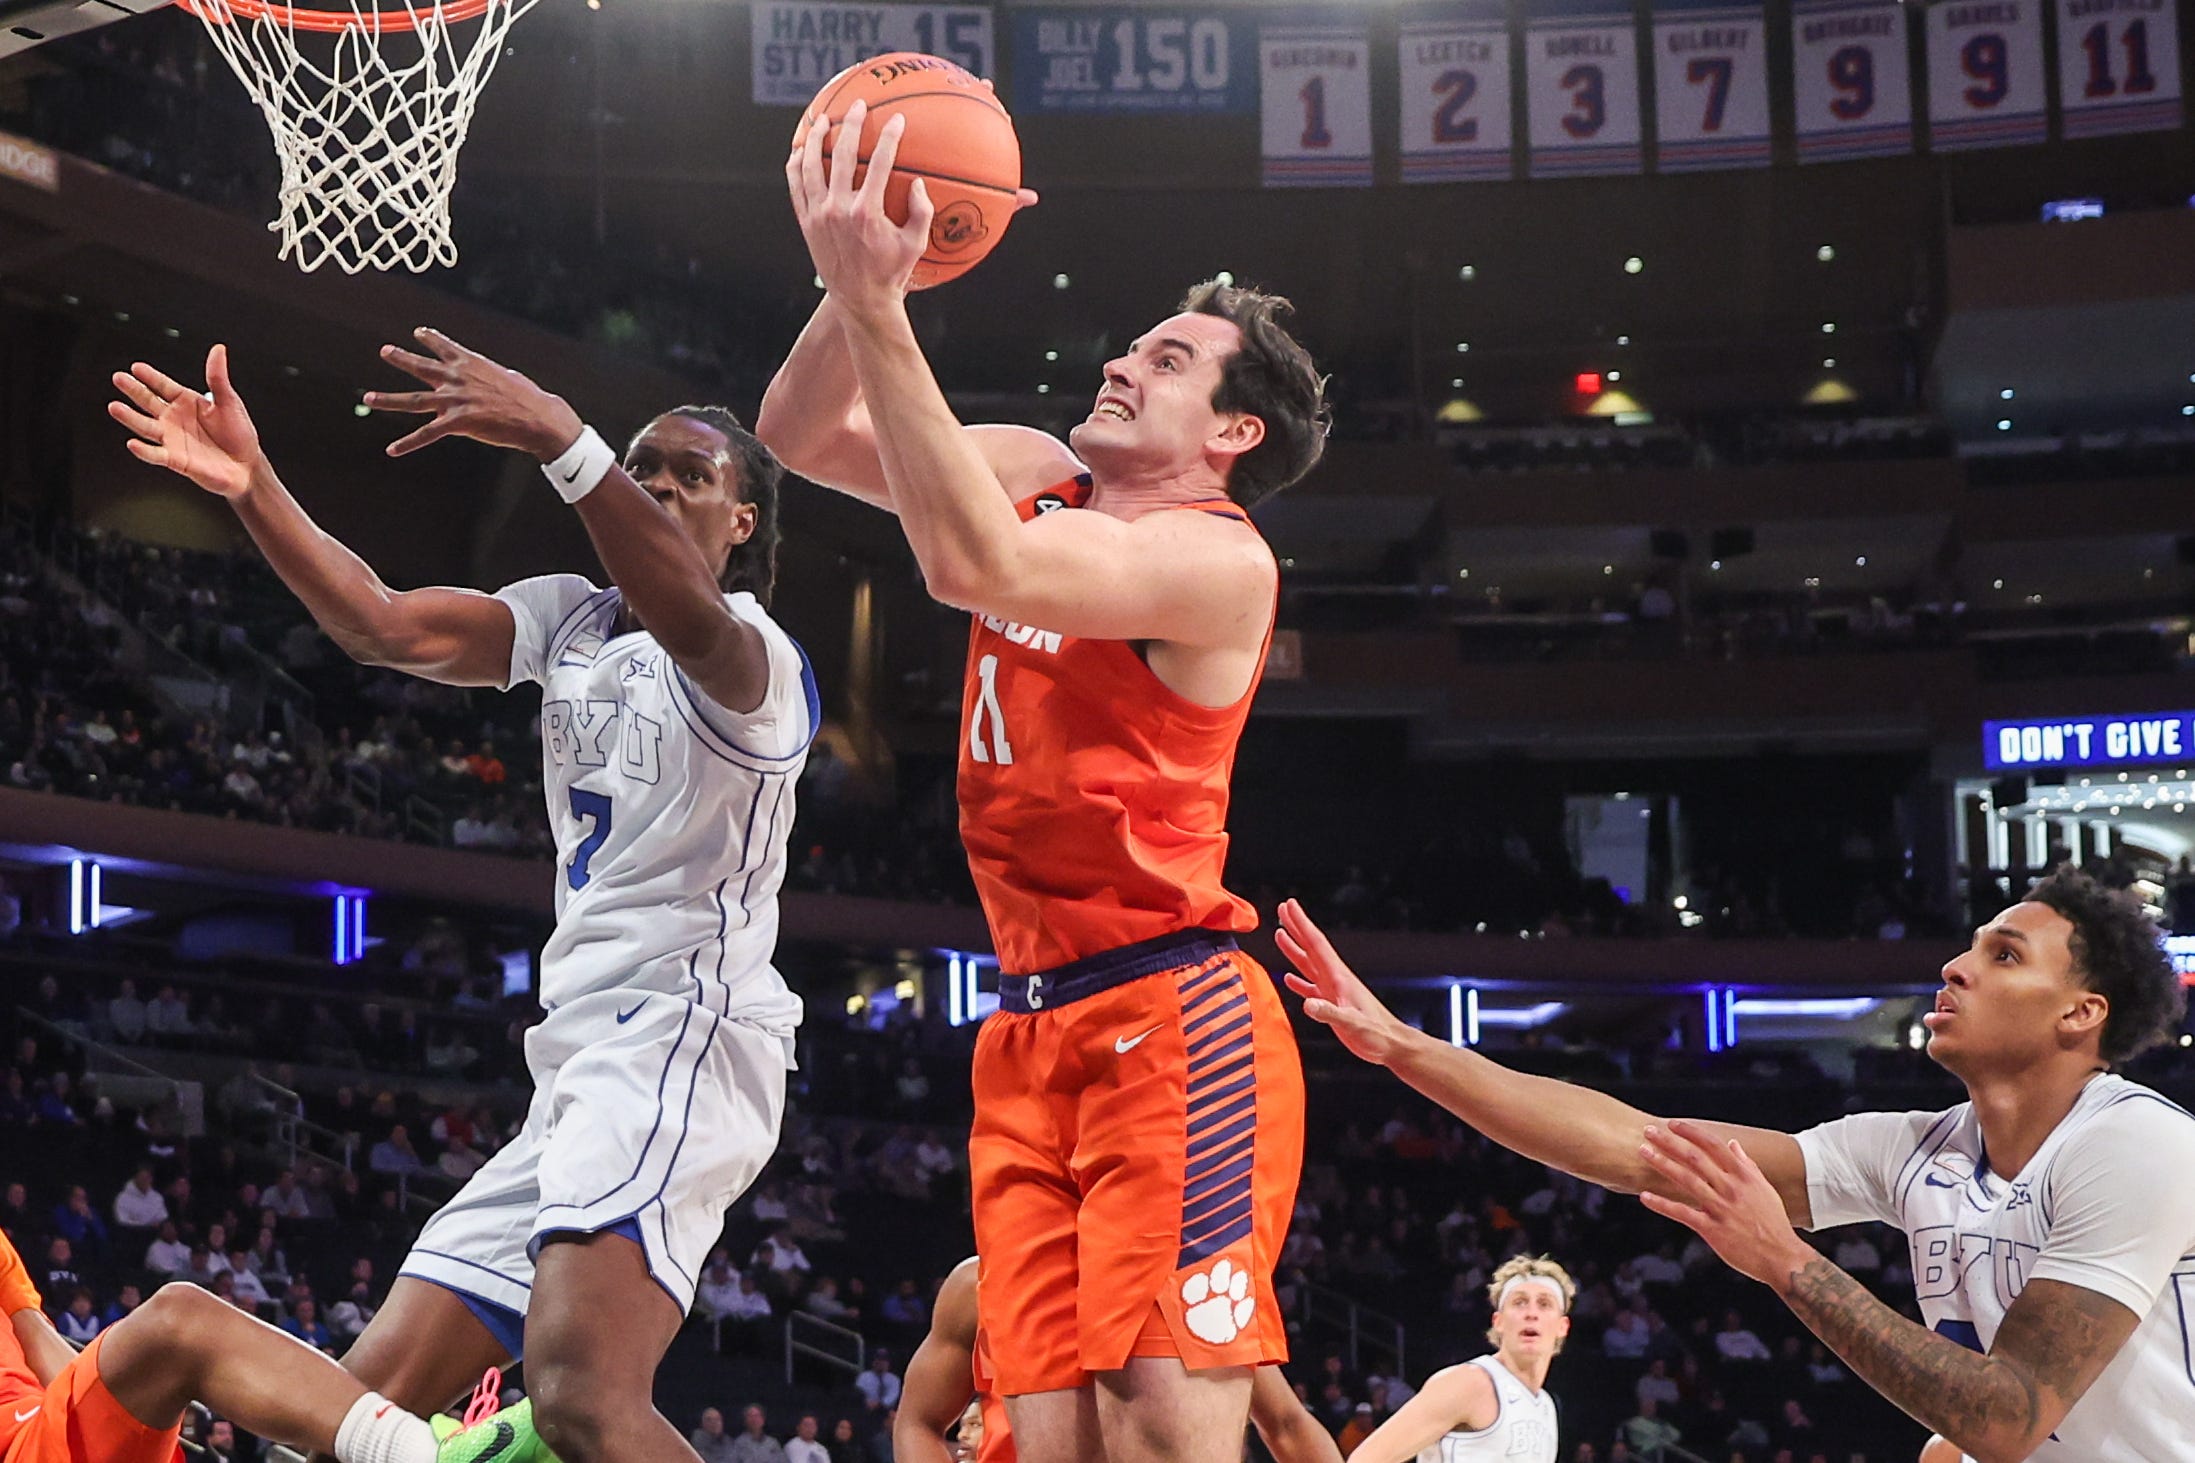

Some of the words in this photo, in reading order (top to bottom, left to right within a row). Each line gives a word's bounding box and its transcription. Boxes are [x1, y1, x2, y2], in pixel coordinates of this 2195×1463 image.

[772, 10, 884, 40] HARRY
[914, 12, 984, 79] 15
[1111, 18, 1228, 91] 150
[2082, 18, 2156, 97] 11
[1431, 69, 1478, 144] 2
[1559, 63, 1605, 138] 3
[1686, 57, 1732, 132] 7
[1827, 44, 1874, 120] 9
[1959, 33, 2008, 109] 9
[1299, 75, 1332, 148] 1
[543, 700, 662, 786] BYU
[971, 654, 1013, 765] 11
[2000, 723, 2094, 763] DON'T
[2106, 719, 2182, 758] GIVE
[566, 784, 612, 892] 7
[1913, 1224, 2041, 1312] BYU
